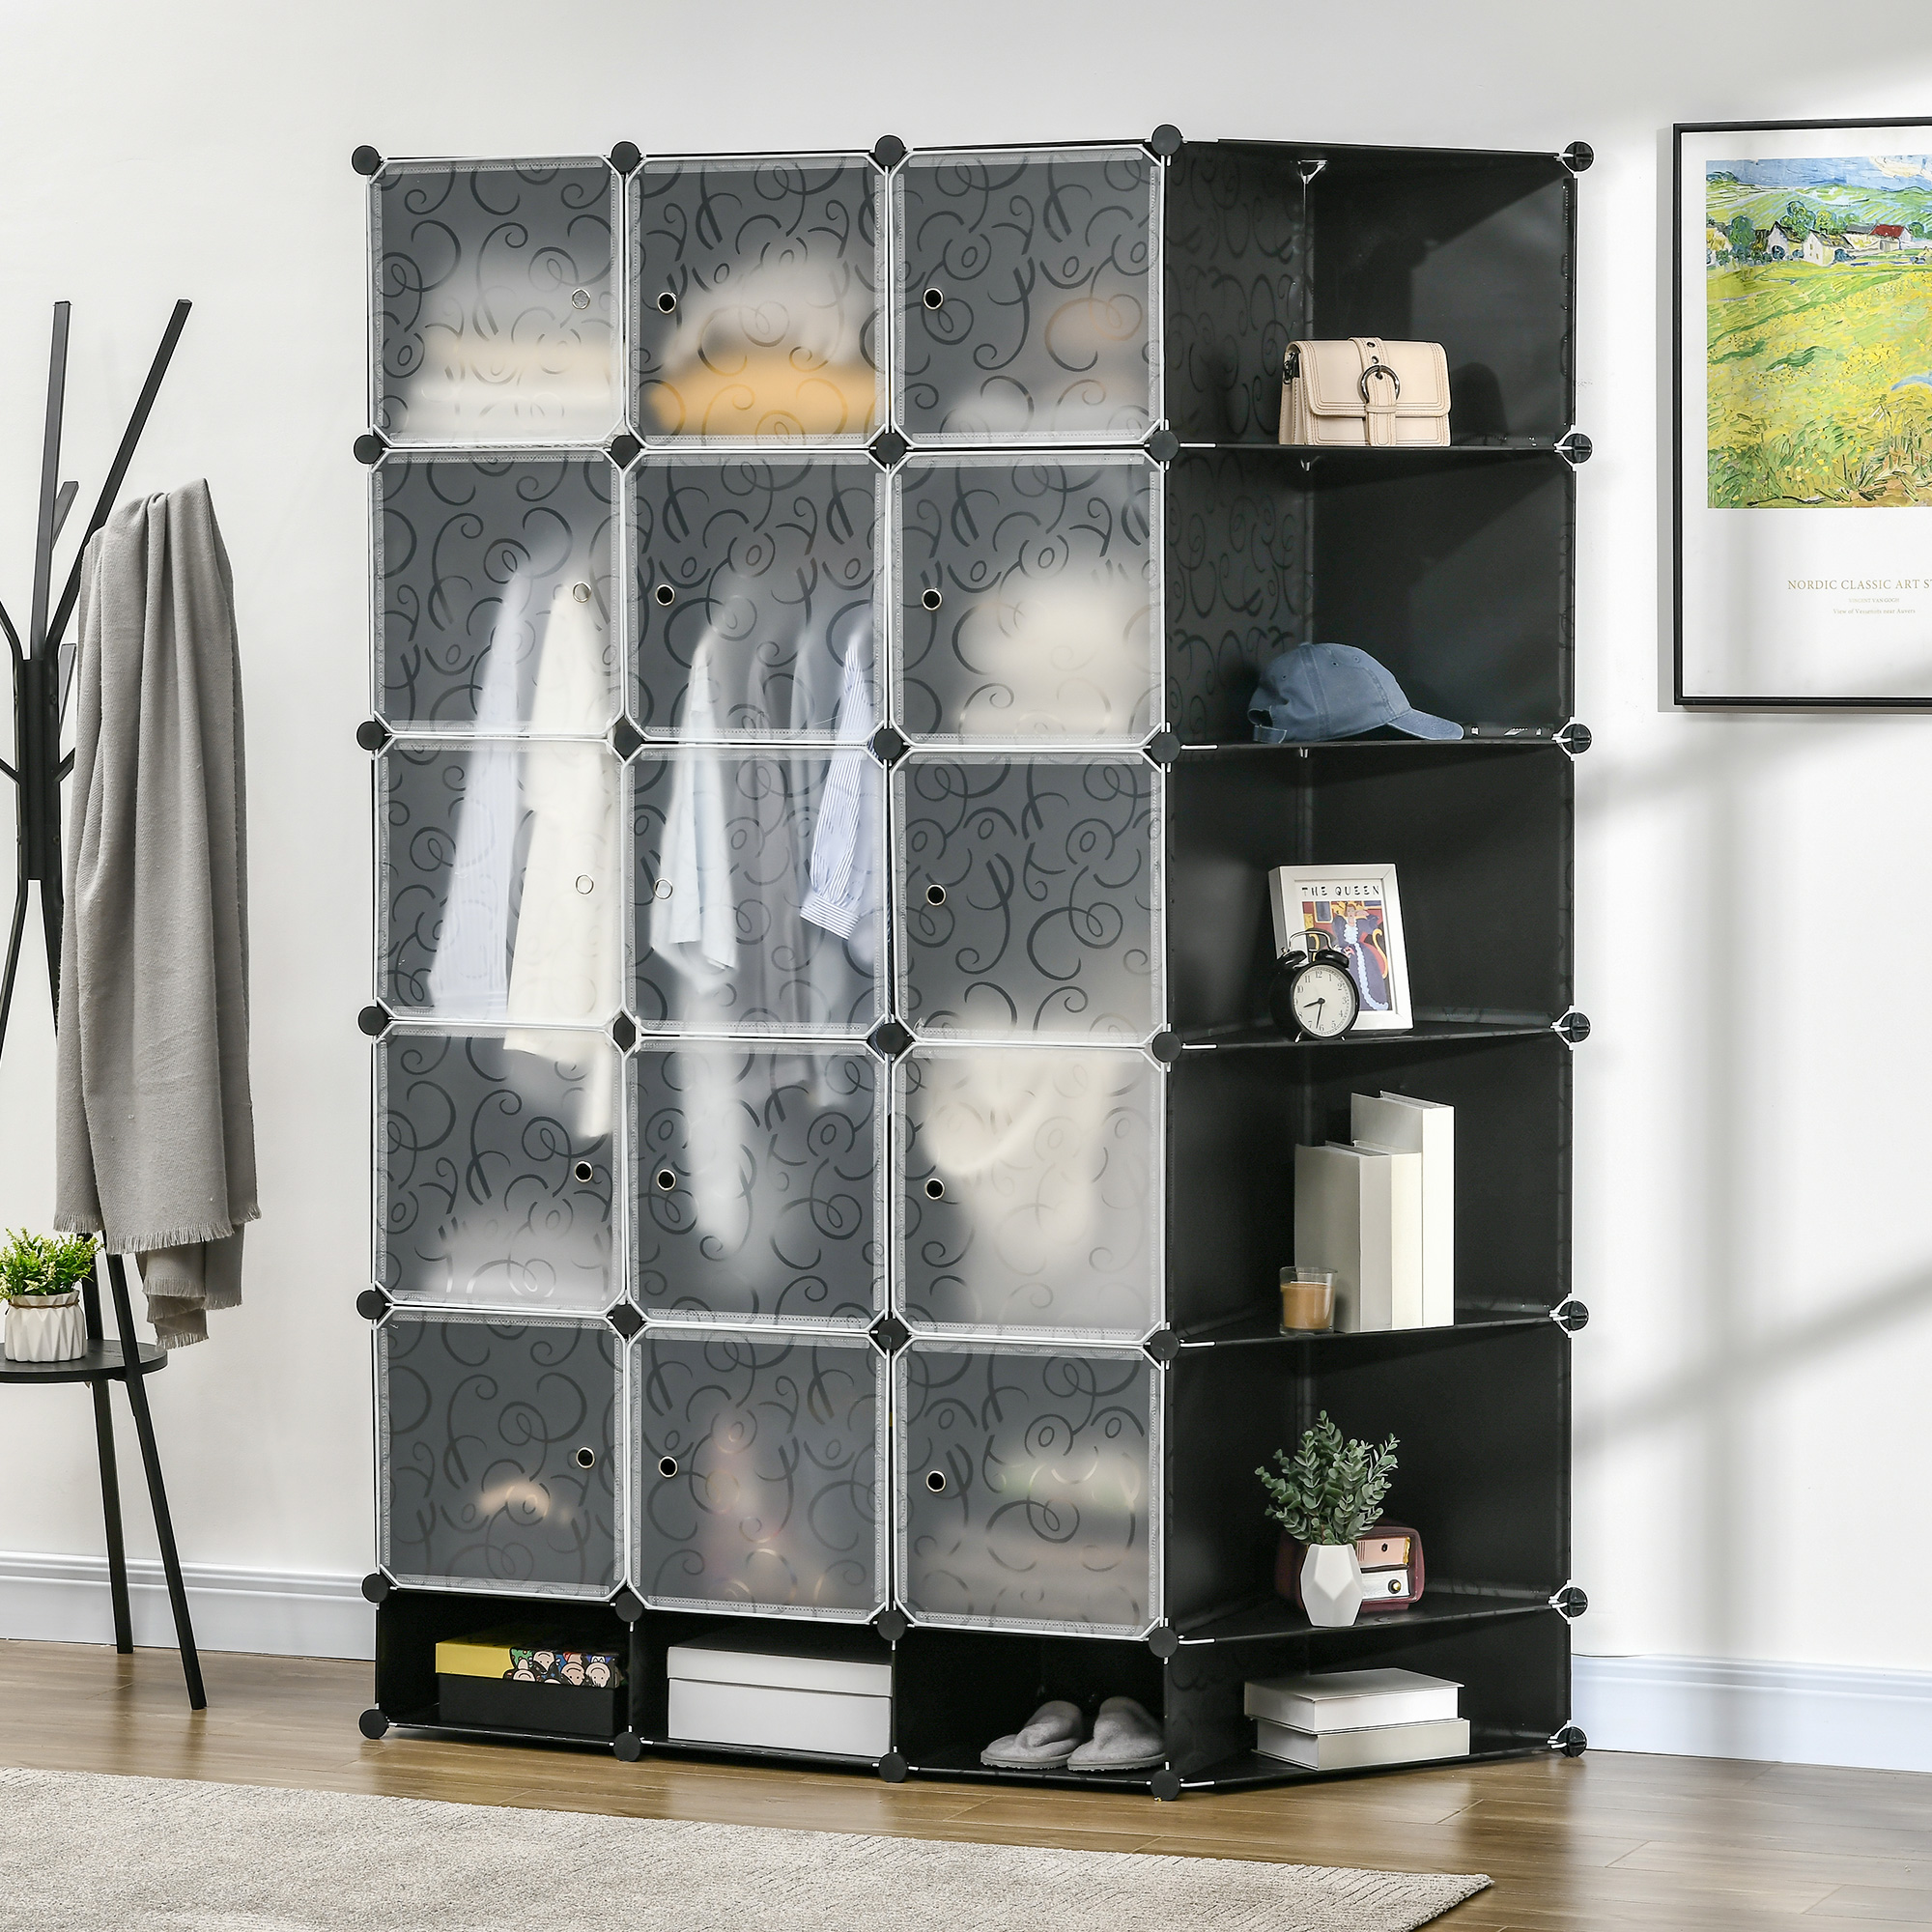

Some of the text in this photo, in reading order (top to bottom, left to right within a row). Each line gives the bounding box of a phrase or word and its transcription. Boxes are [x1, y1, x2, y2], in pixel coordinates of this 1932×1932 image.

[1787, 580, 1837, 590] NORDIC
[1840, 580, 1891, 590] CLASSIC
[1895, 579, 1919, 589] ART
[1301, 885, 1379, 896] THE QUEEN
[1304, 975, 1311, 983] 11
[1315, 970, 1322, 979] 12
[1337, 982, 1343, 991] 2
[1342, 996, 1347, 1005] 3
[1338, 1009, 1344, 1018] 4
[1308, 1020, 1313, 1029] 7
